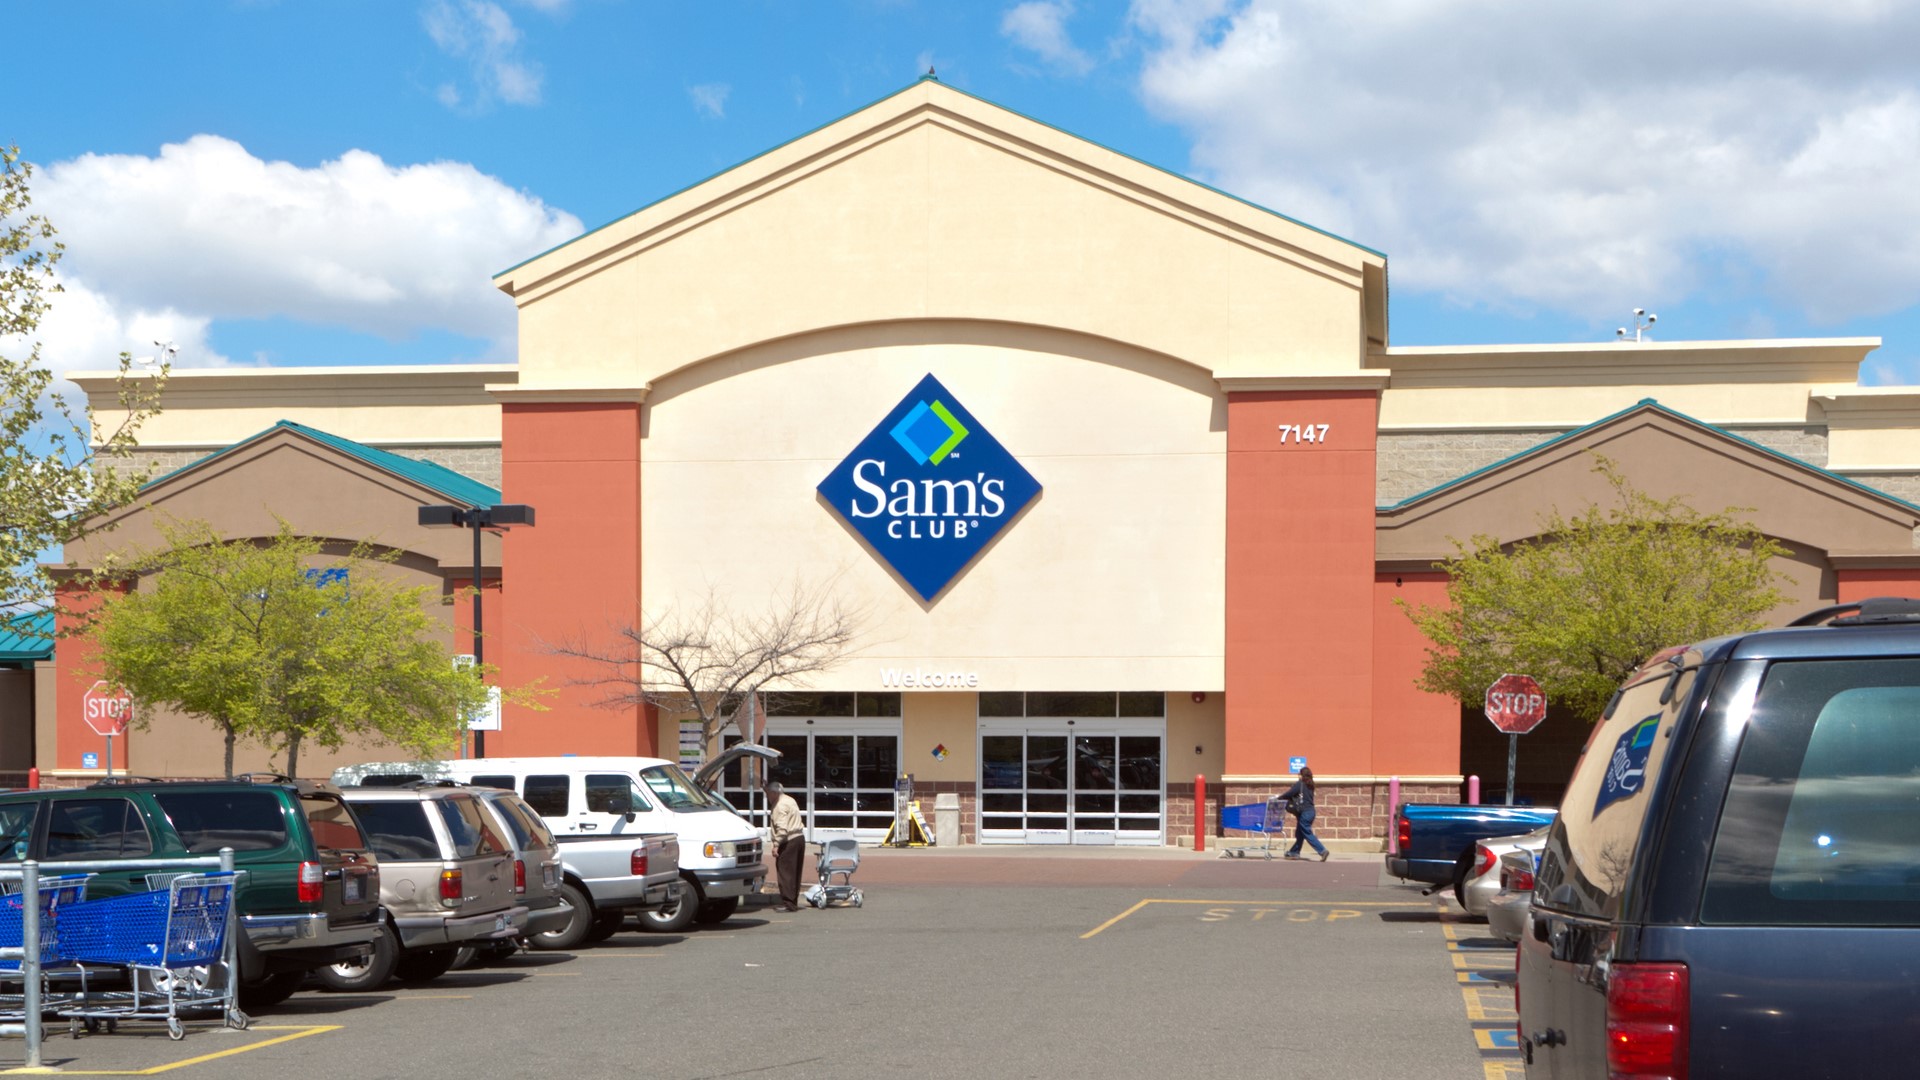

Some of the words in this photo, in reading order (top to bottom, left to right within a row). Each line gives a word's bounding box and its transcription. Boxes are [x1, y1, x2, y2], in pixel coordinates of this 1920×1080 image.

[1278, 424, 1330, 444] 7147
[851, 458, 1006, 518] Sam's
[879, 667, 978, 688] Welcome
[88, 697, 130, 718] STOP
[1490, 691, 1542, 715] STOP
[1196, 907, 1364, 922] STOP
